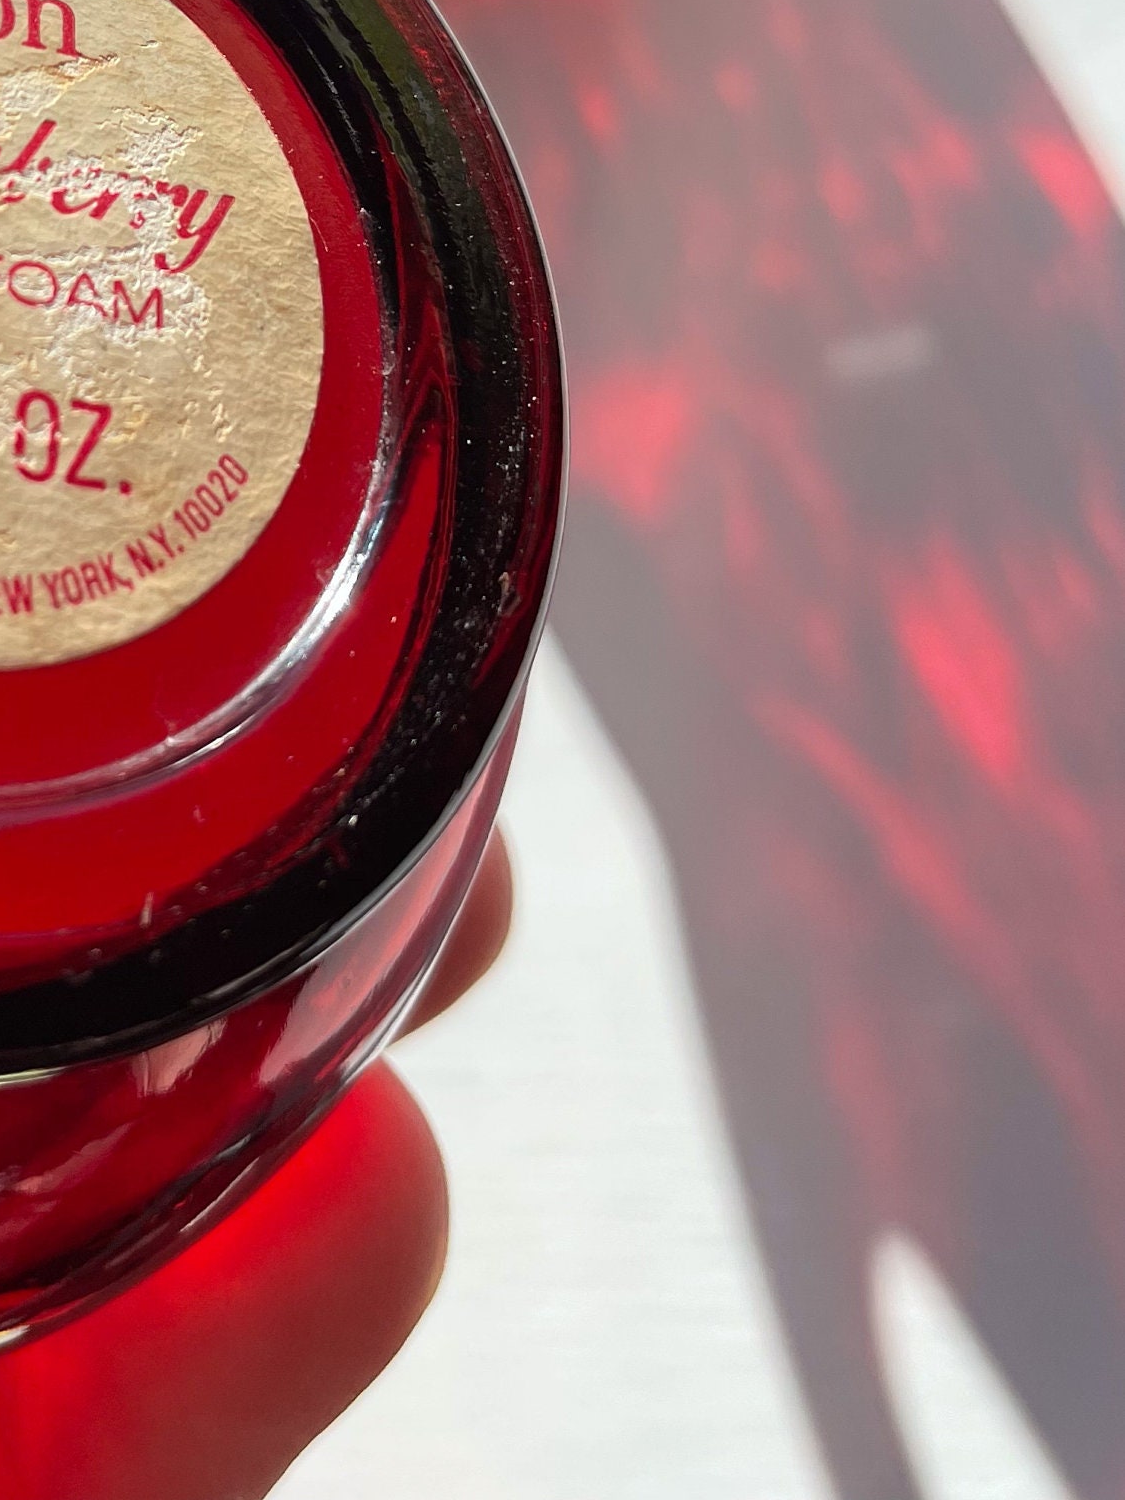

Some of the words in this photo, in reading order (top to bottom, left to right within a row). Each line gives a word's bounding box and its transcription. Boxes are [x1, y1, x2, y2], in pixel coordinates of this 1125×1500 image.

[13, 390, 133, 496] OZ.
[38, 553, 135, 610] YORK,
[126, 524, 185, 579] N.Y.
[174, 453, 249, 540] 10020
